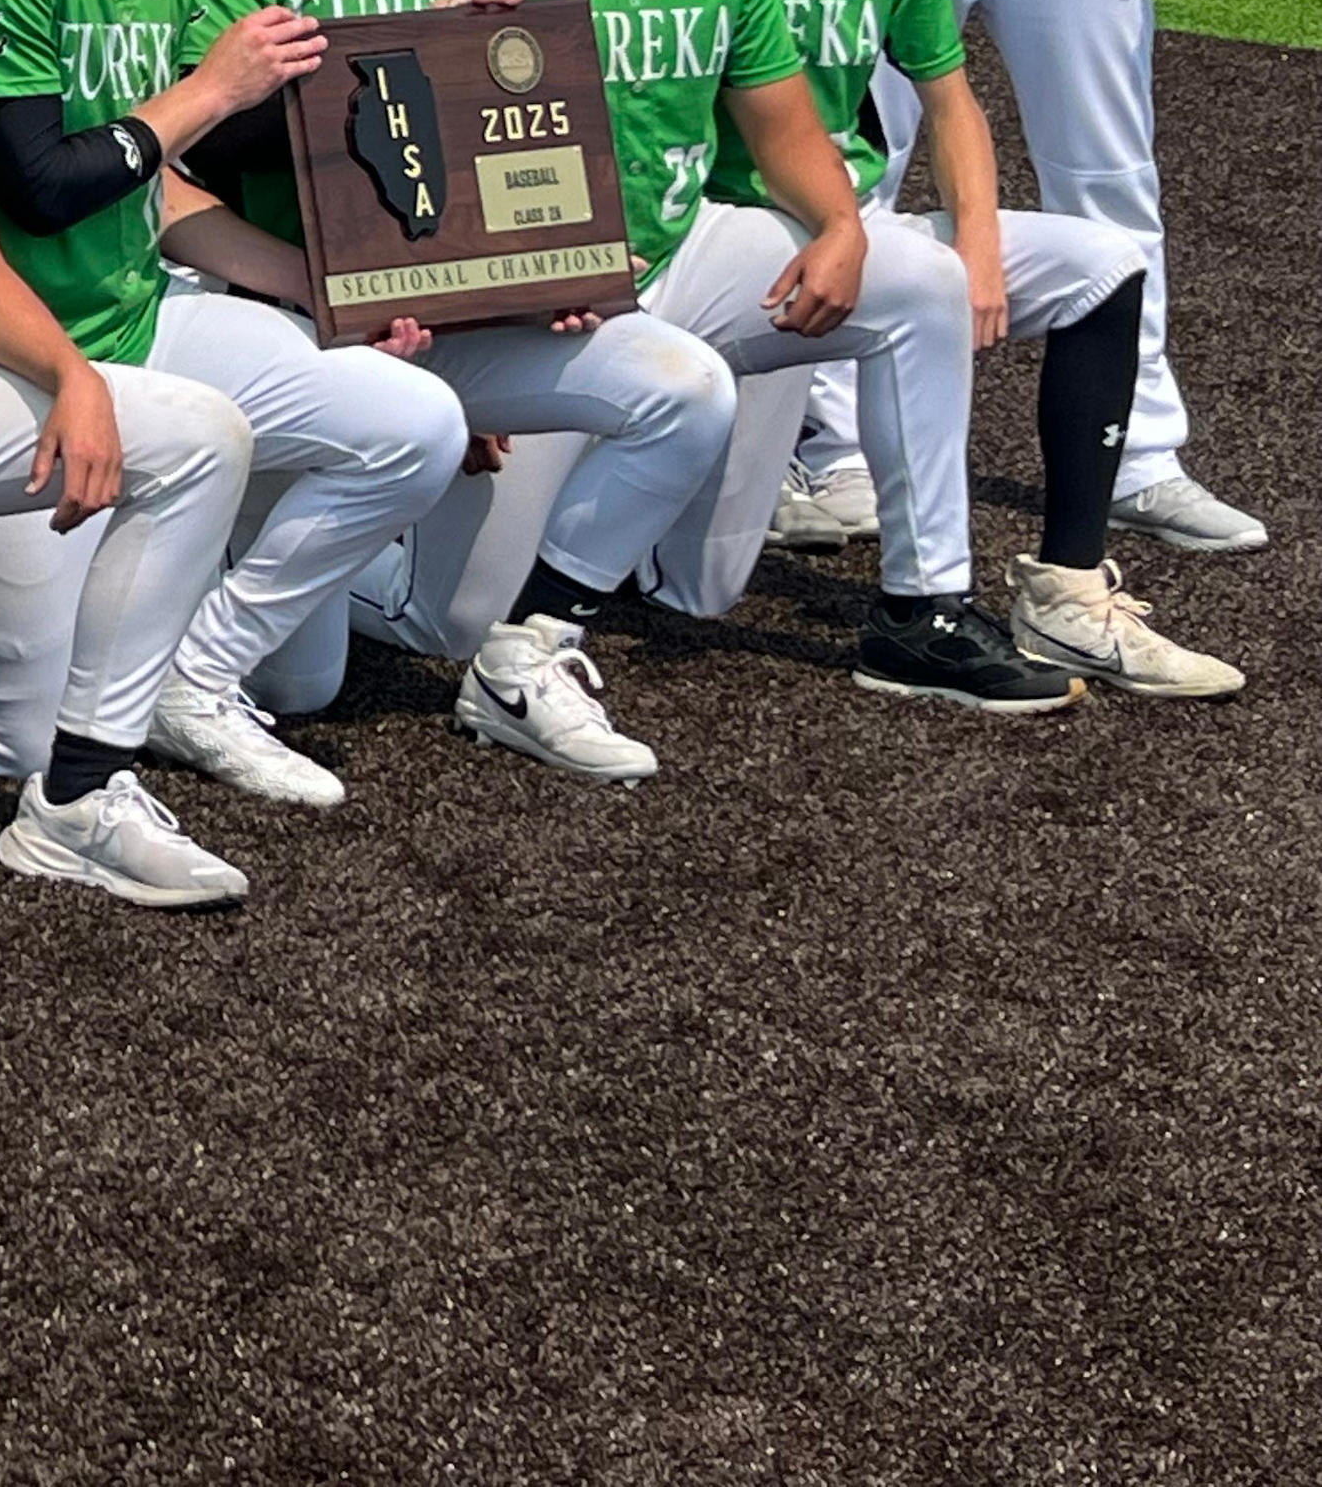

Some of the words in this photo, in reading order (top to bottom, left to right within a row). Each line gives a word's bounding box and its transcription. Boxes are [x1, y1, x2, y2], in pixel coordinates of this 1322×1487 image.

[58, 21, 177, 103] EUREK
[591, 5, 731, 82] REKA
[376, 66, 435, 217] IHSA
[480, 100, 570, 143] 2025
[504, 167, 560, 190] BASEBALL
[513, 207, 545, 225] CLASS
[342, 264, 469, 299] SECTIONAL
[487, 246, 616, 282] CHAMPIONS
